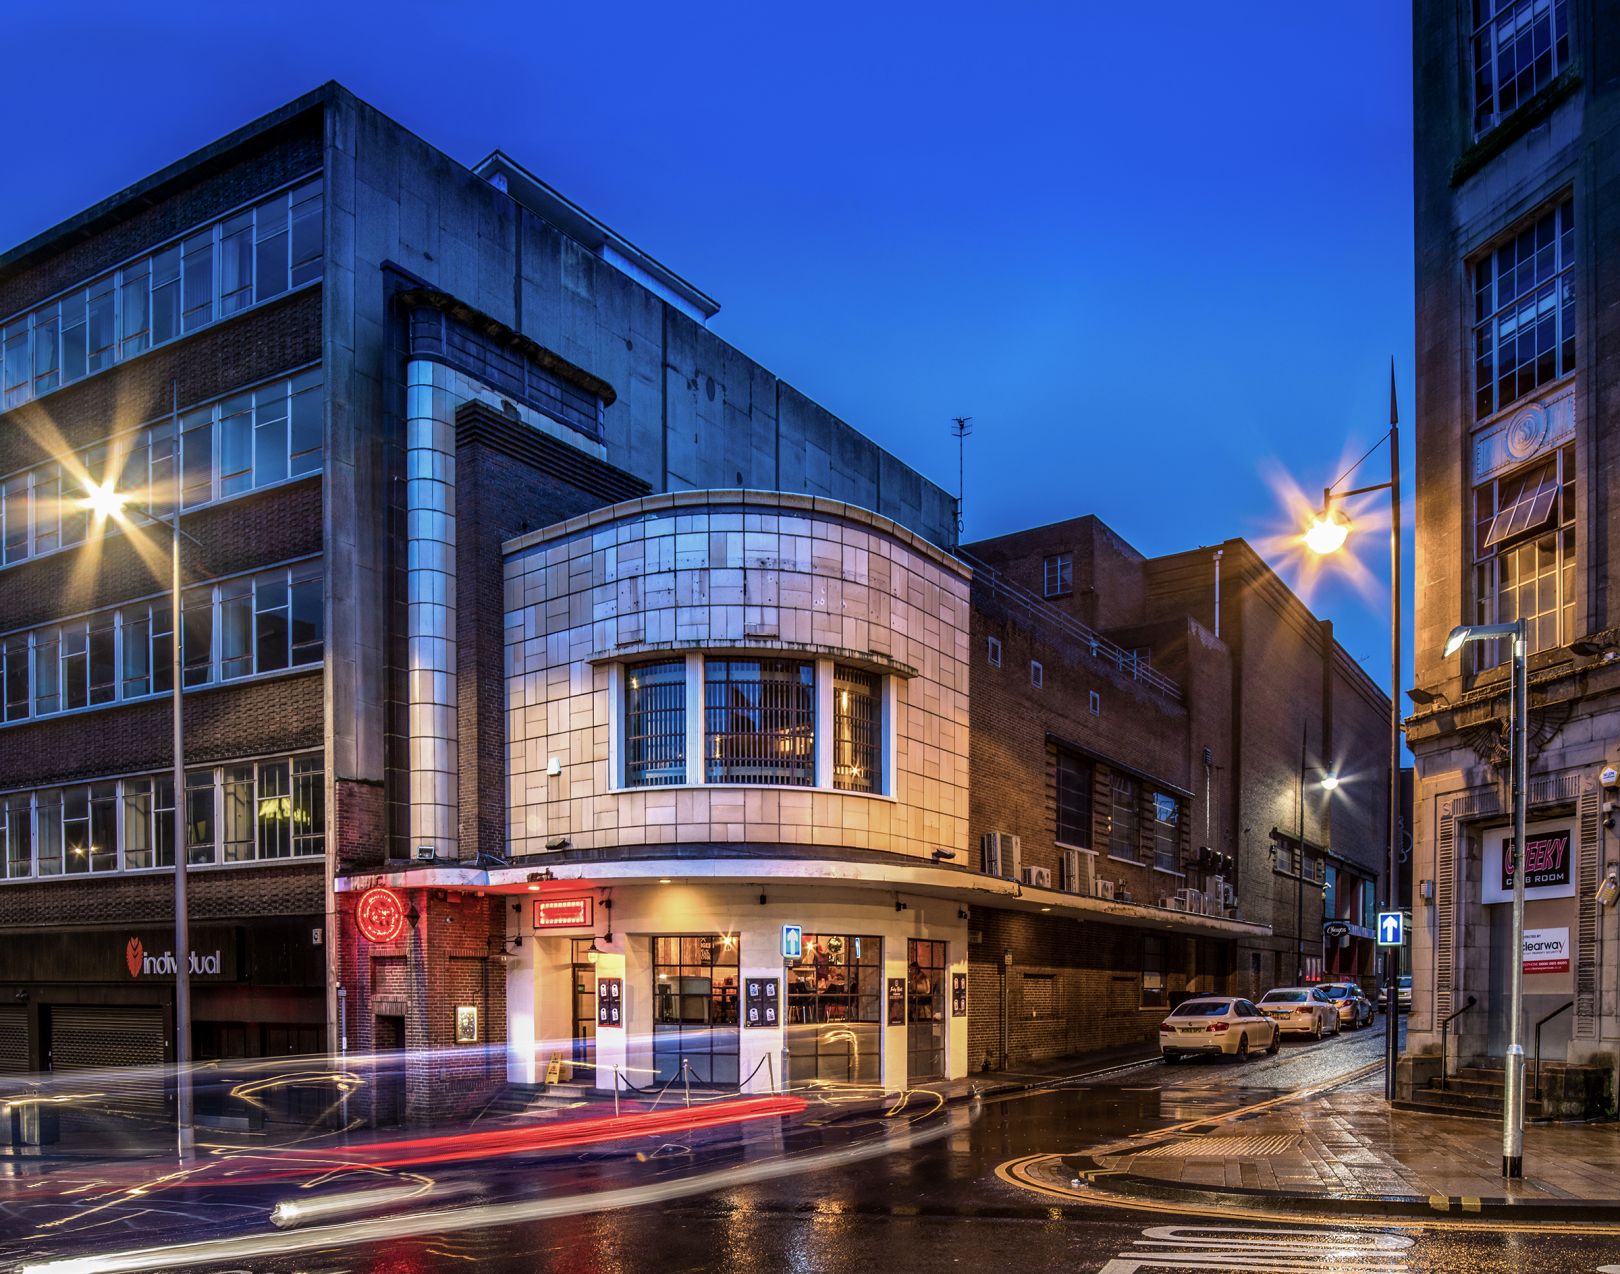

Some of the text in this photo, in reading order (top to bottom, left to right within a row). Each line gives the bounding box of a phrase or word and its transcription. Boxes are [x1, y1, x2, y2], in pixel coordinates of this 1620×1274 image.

[1505, 837, 1568, 875] CEEKY
[1506, 874, 1564, 886] CB ROOM
[143, 950, 220, 974] indivdual
